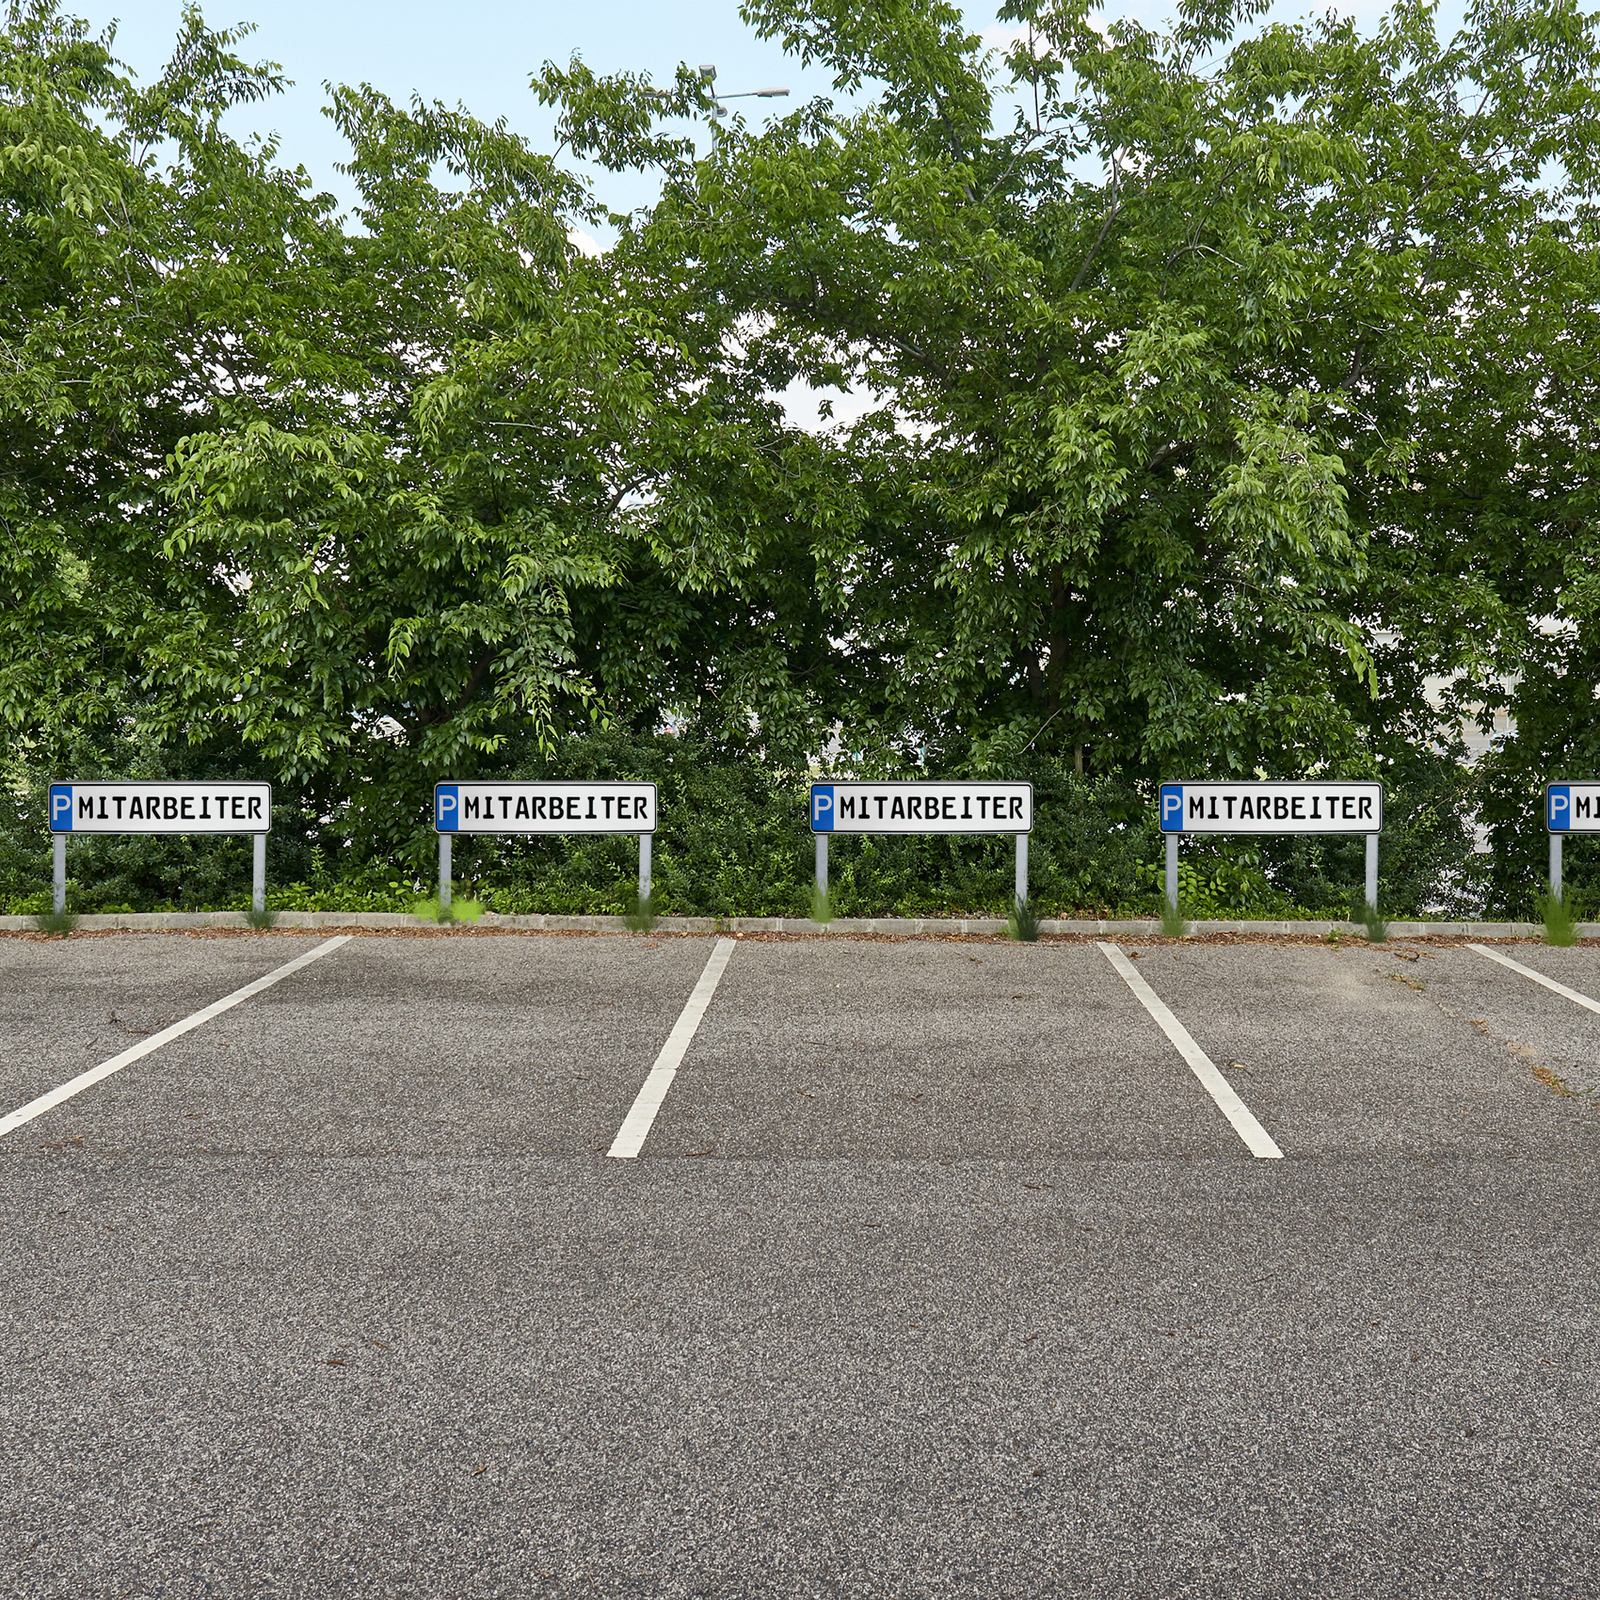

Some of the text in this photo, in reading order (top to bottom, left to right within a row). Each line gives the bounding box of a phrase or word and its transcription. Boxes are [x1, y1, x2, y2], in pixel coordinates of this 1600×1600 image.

[53, 794, 262, 820] P MITARBEITER
[438, 794, 648, 820] P MITARBEITER
[814, 794, 1024, 820] P MITARBEITER
[1163, 794, 1373, 820] P MITARBEITER
[1551, 794, 1569, 820] P
